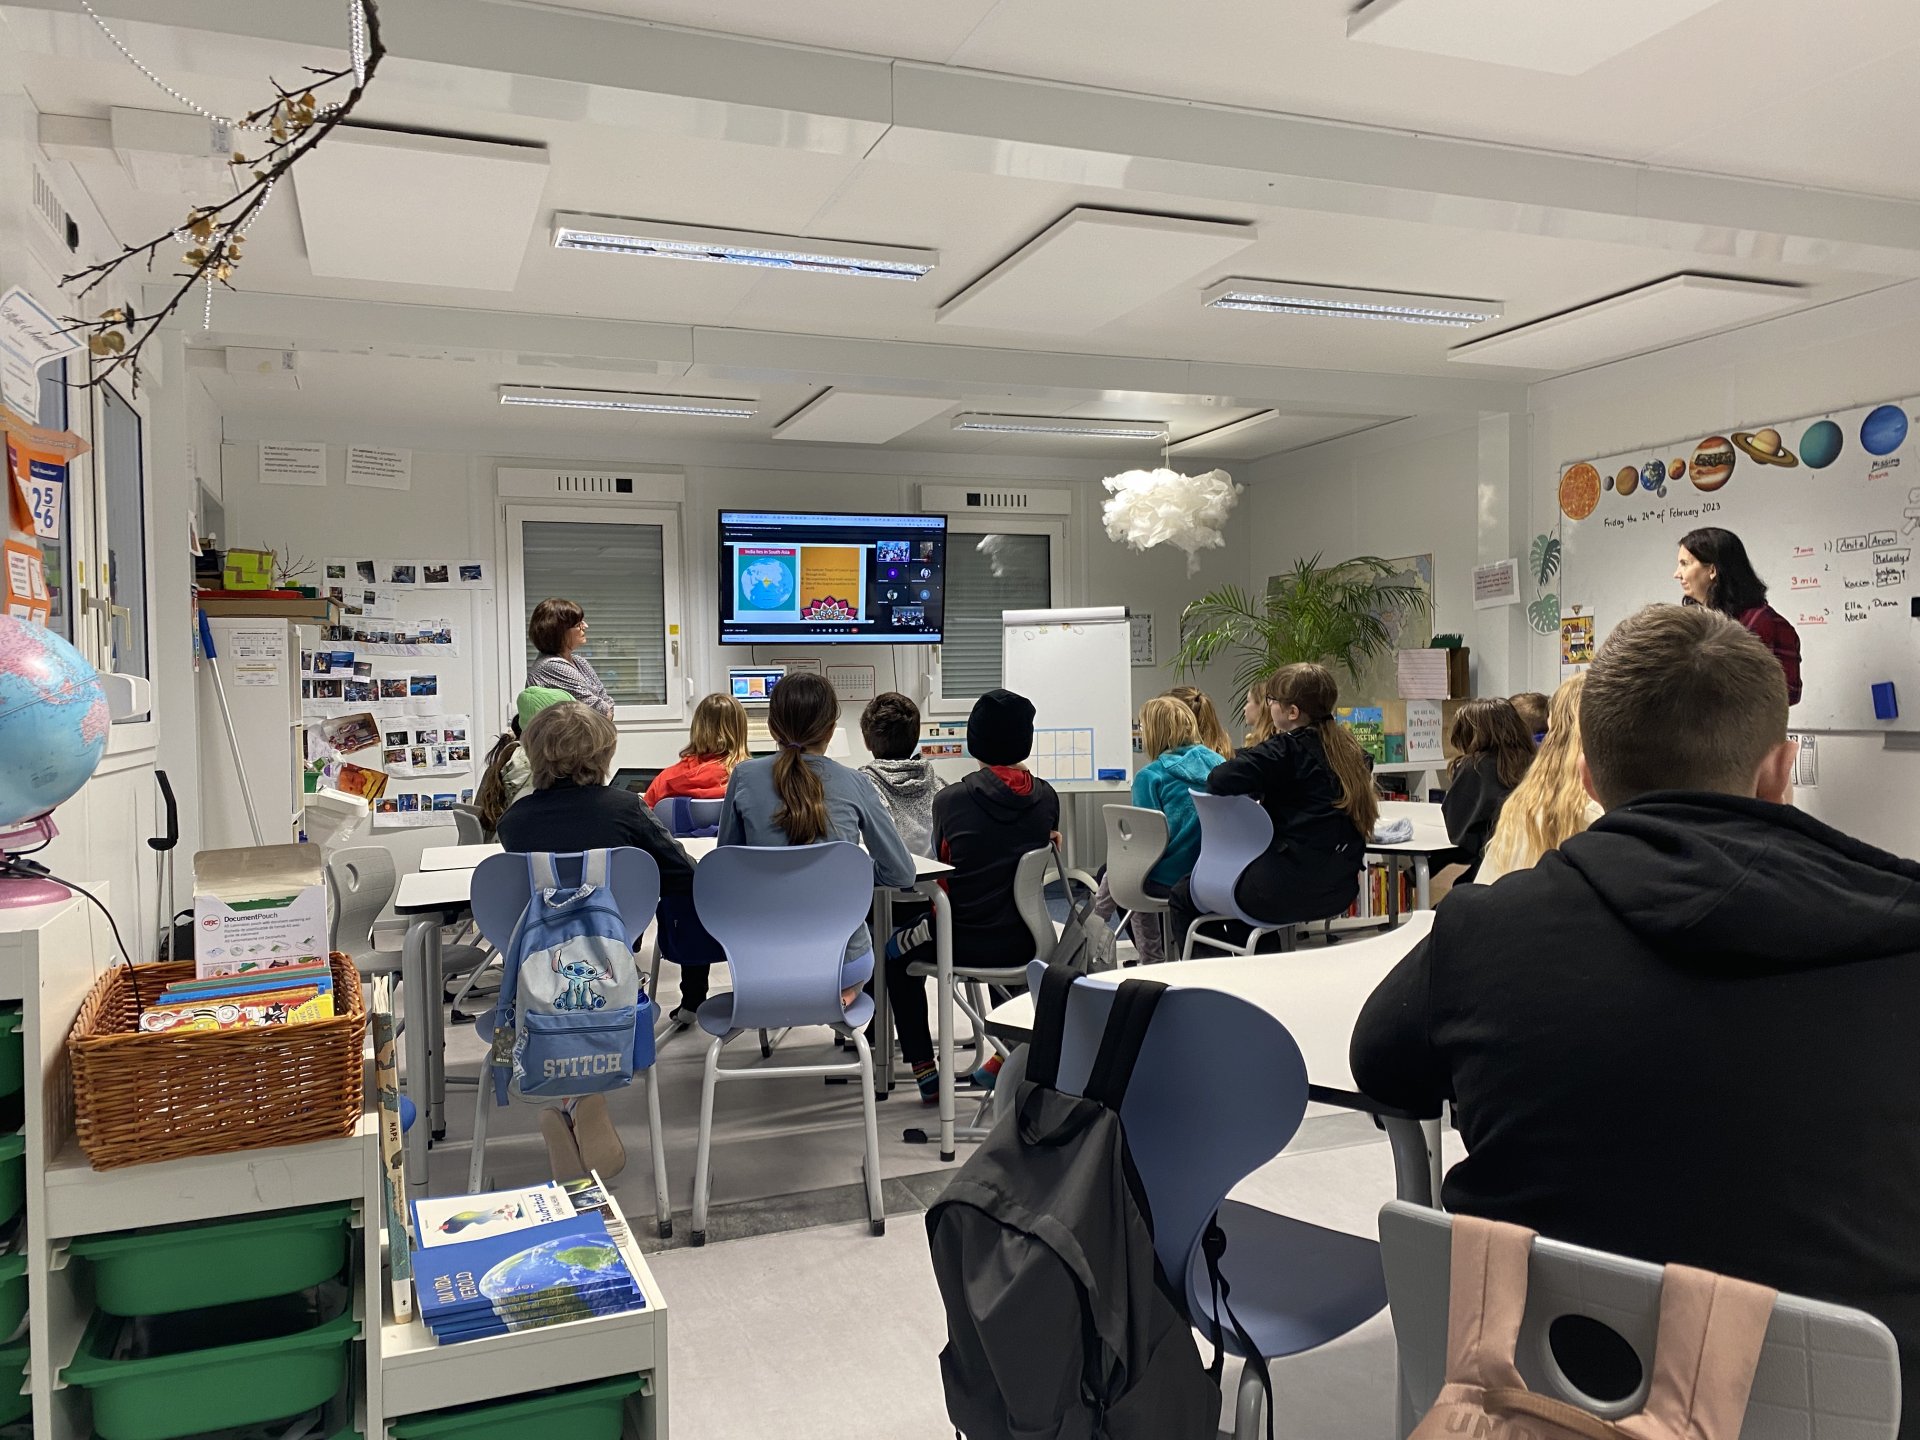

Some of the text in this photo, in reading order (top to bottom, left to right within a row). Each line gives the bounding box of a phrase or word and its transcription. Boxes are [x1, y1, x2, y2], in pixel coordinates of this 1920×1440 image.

[1871, 457, 1900, 470] Missing
[32, 487, 42, 519] 2
[44, 487, 54, 505] 5
[43, 508, 54, 529] 6
[1604, 517, 1625, 529] Friday
[1627, 514, 1638, 522] the
[1657, 509, 1665, 524] of
[1669, 507, 1699, 518] February
[1702, 502, 1721, 513] 2023
[1871, 535, 1895, 545] Aron
[1872, 598, 1899, 608] Diana
[1808, 613, 1825, 623] min
[224, 912, 278, 923] DocumentPouch
[543, 1053, 622, 1078] STITCH
